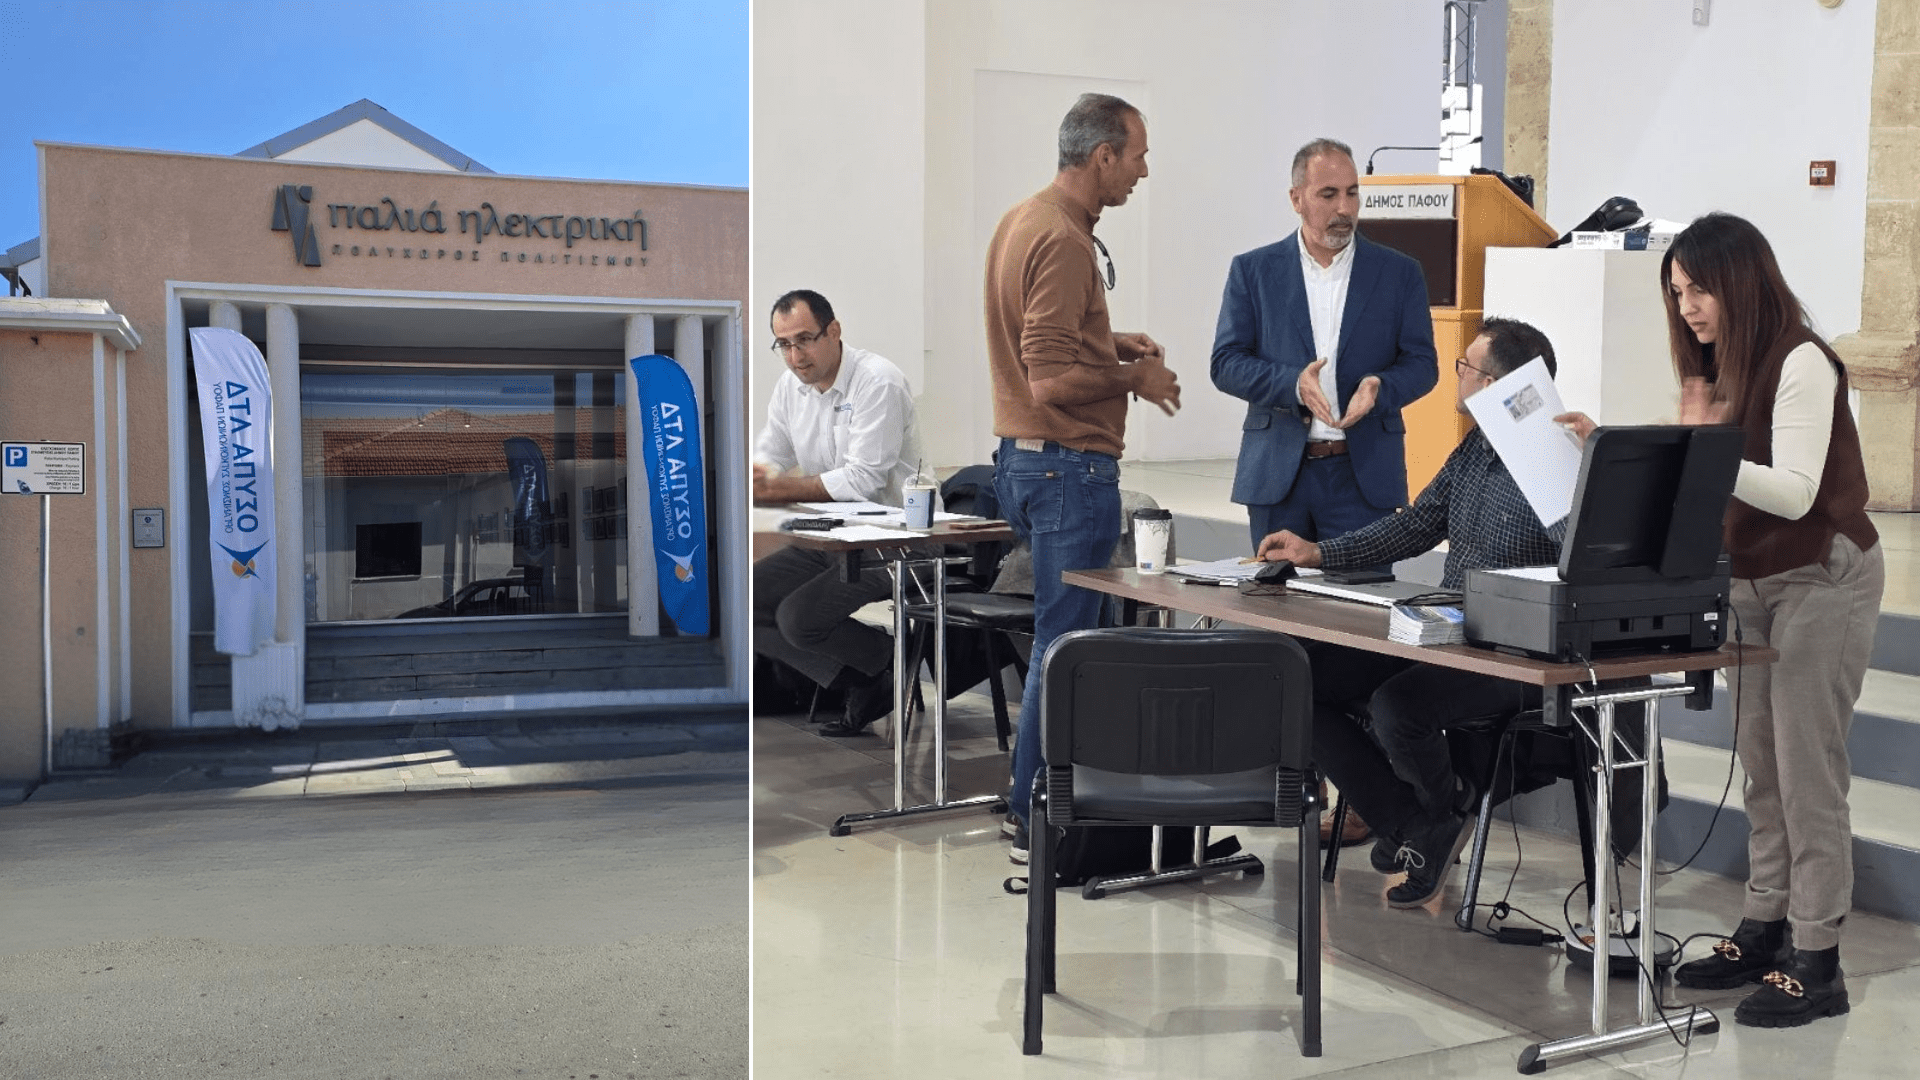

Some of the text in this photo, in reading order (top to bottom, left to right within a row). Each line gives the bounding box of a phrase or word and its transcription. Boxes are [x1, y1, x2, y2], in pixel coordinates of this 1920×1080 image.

[1365, 194, 1449, 208] ΔΗΜΟΣ ΠΑΦΟΥ
[328, 197, 647, 251] παλιά ηλεκτρική
[331, 243, 649, 268] ΠΟΛΥΧΩΡΟΣ ΠΟΛΙΤΙΣΜΟΥ
[9, 448, 24, 466] P
